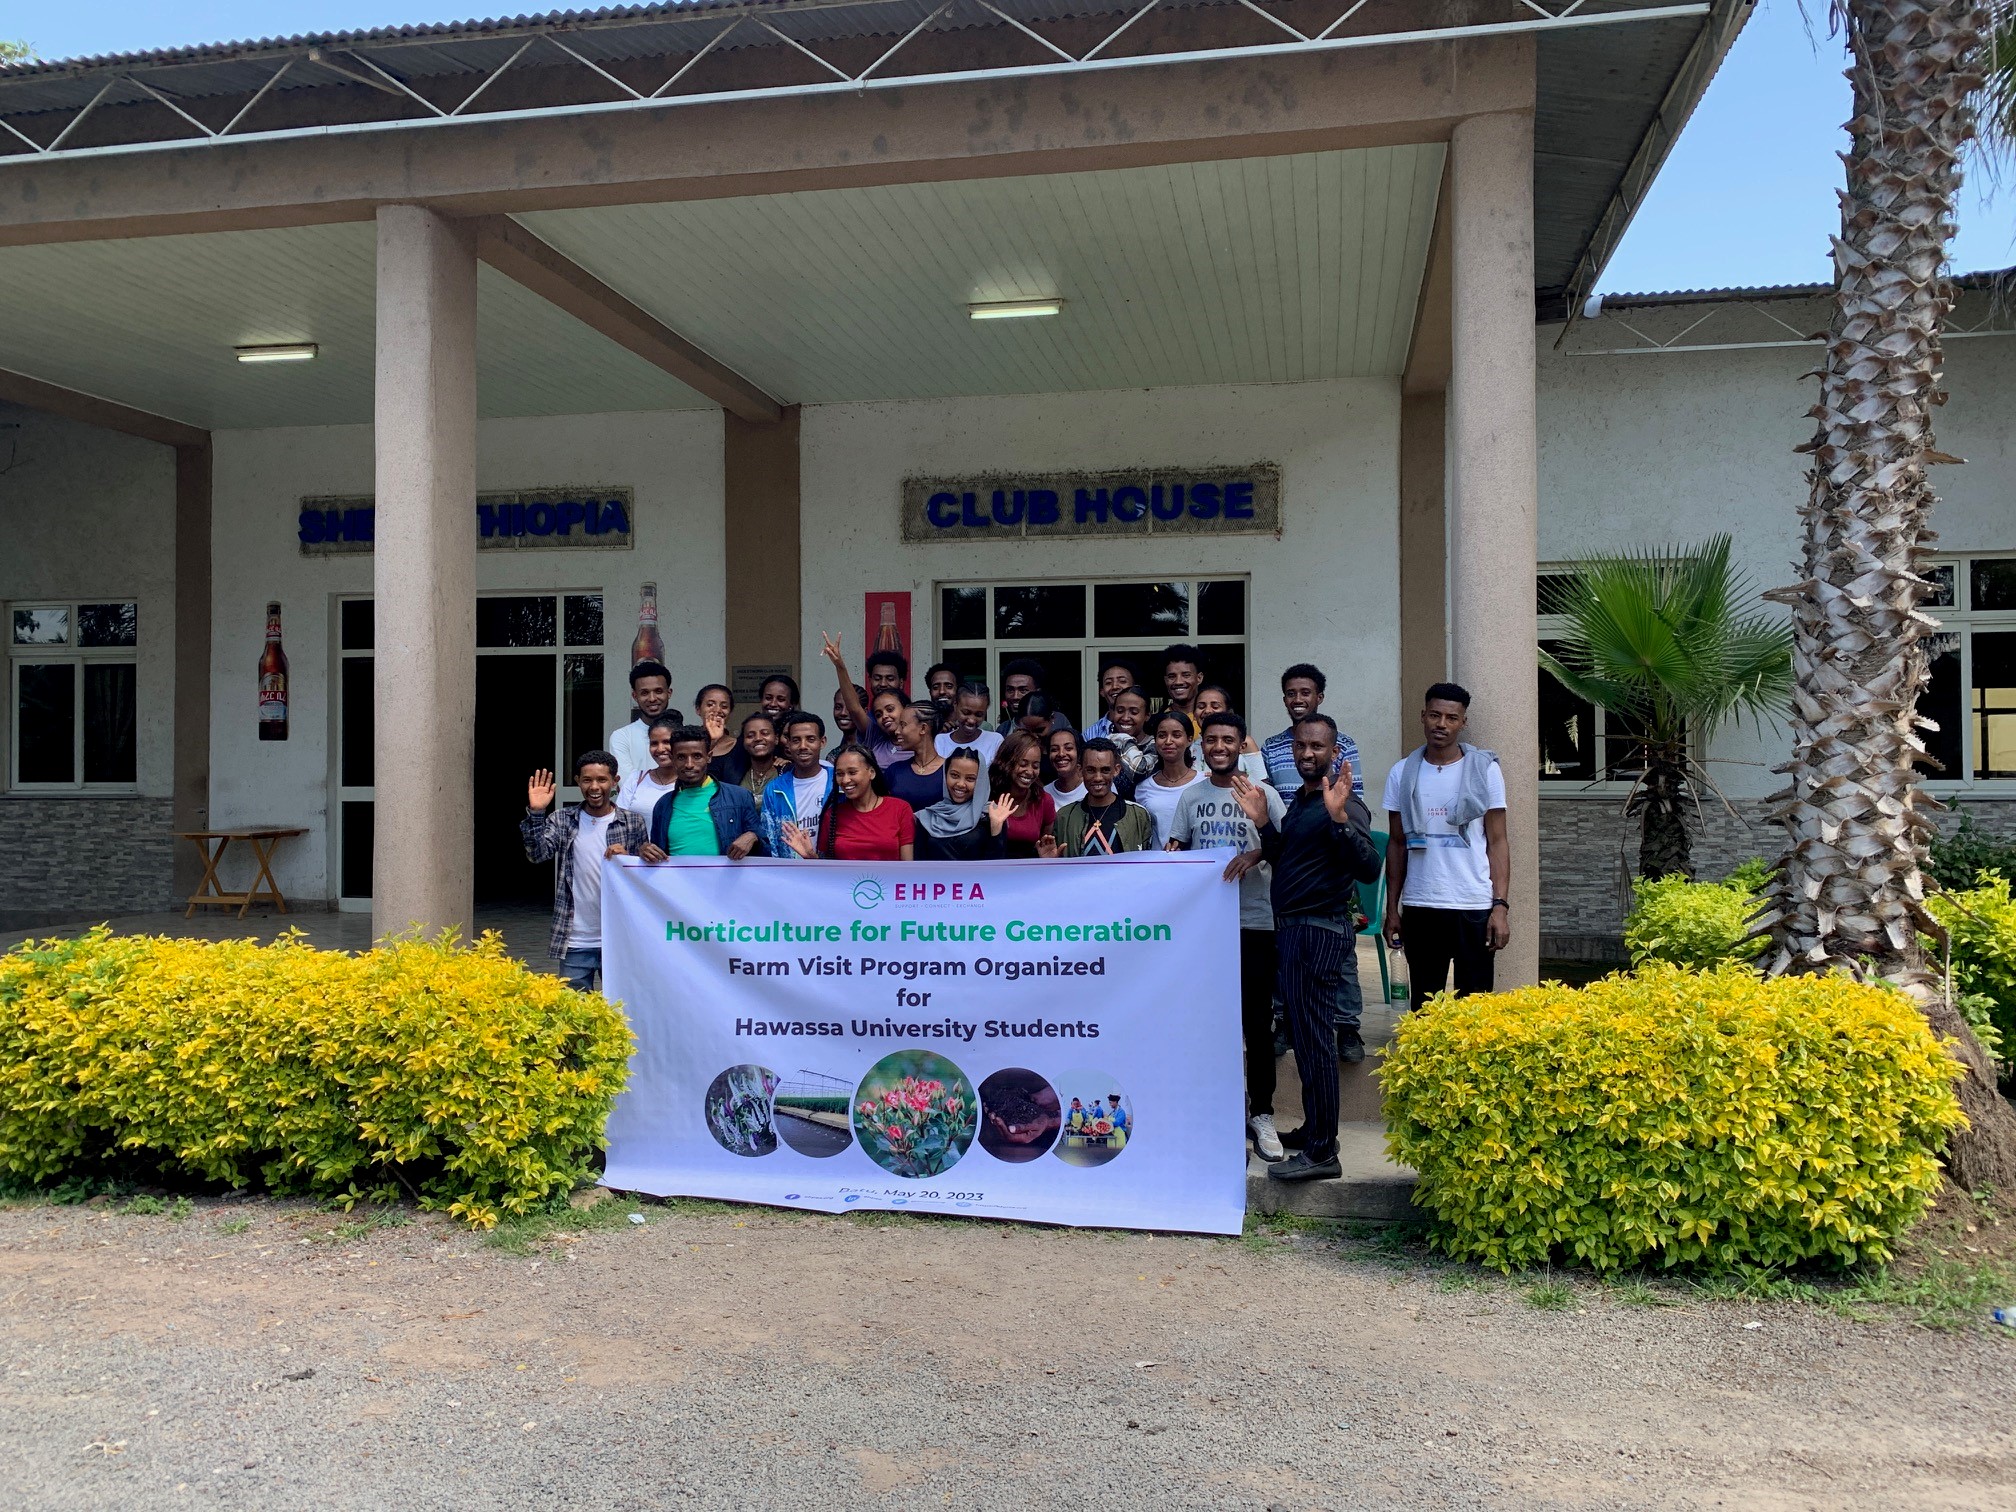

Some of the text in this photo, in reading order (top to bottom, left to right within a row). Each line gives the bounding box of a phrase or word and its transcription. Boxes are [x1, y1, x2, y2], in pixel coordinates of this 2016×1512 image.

[926, 483, 1255, 528] CLUB HOUSE
[298, 499, 630, 543] SHE HIOPIA
[1196, 802, 1248, 818] NO ON
[1200, 820, 1248, 838] OWNS
[895, 883, 985, 901] EHPEA
[665, 918, 1172, 943] Horticulture for Future Generation
[729, 956, 1106, 980] Farm Visit Program Organized
[896, 987, 932, 1007] for
[735, 1017, 1100, 1043] Hawassa University Students
[883, 1188, 916, 1198] May
[919, 1191, 941, 1200] 20,
[946, 1191, 984, 1201] 2023
